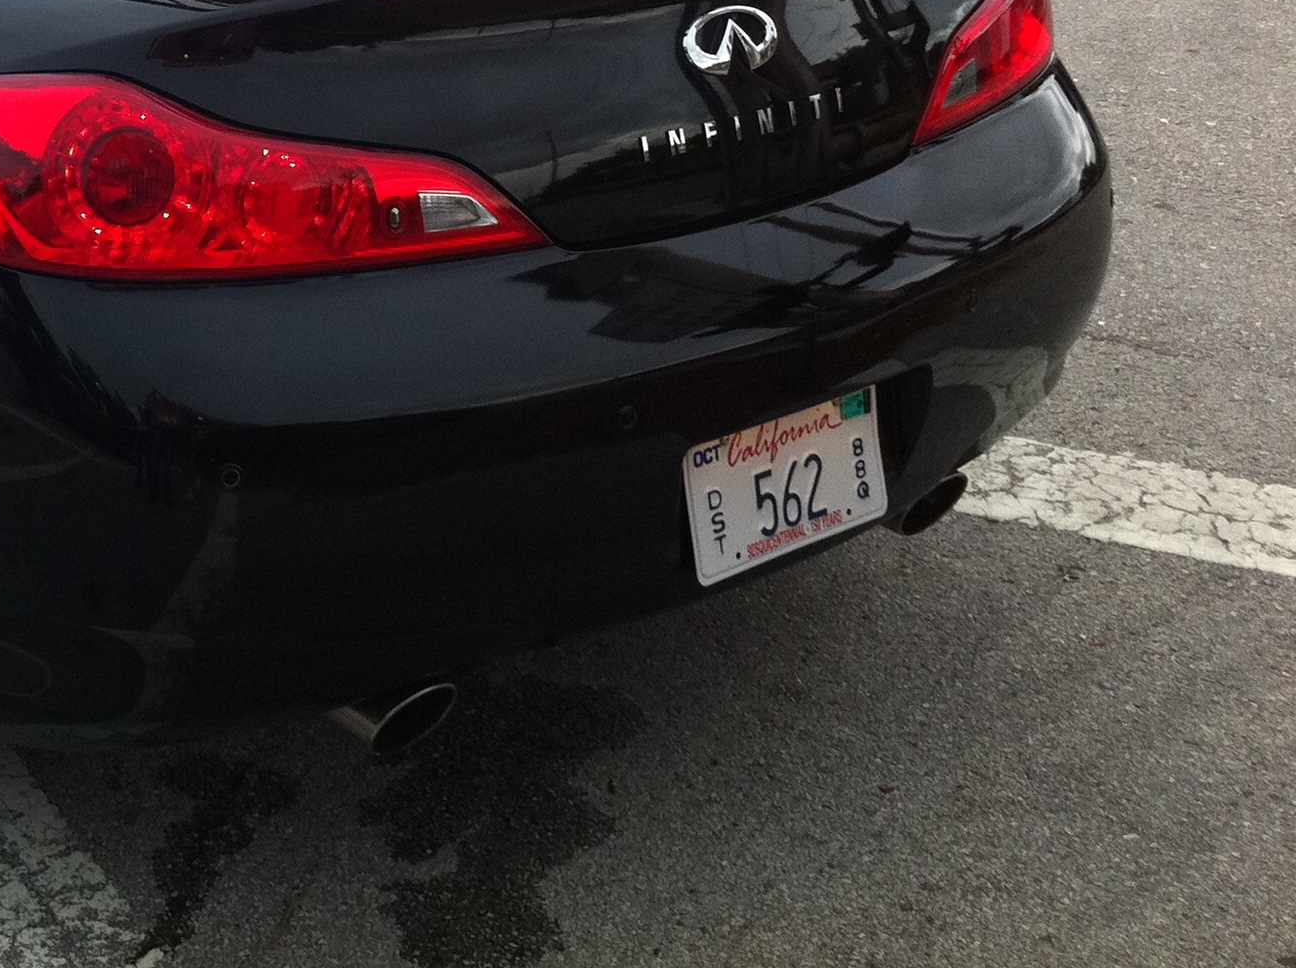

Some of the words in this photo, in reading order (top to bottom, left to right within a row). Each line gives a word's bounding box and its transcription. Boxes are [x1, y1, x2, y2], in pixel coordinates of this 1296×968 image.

[638, 86, 845, 163] INFINITI
[693, 443, 722, 468] OCT
[727, 411, 844, 468] California
[753, 452, 829, 538] 562
